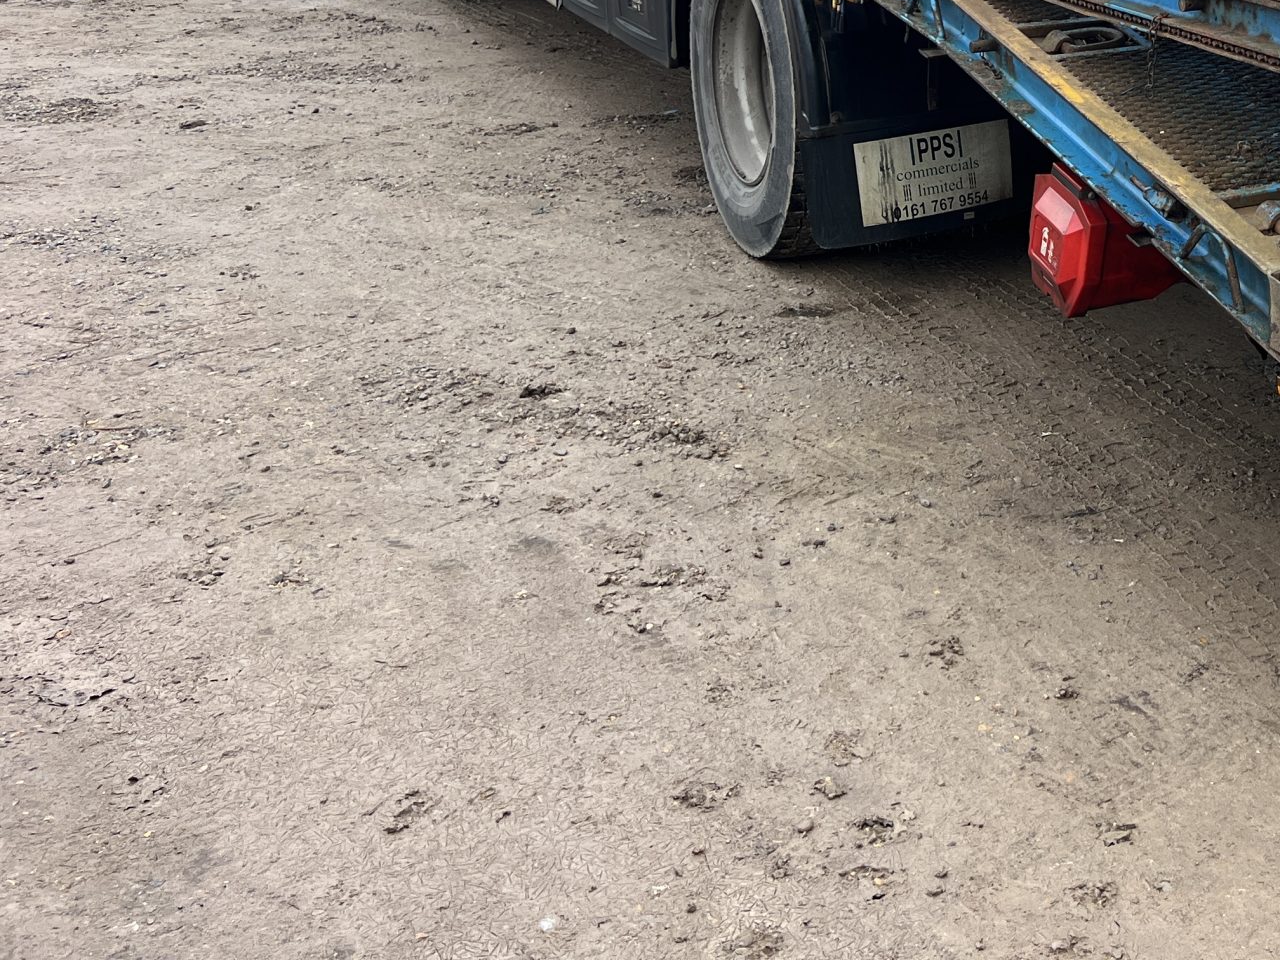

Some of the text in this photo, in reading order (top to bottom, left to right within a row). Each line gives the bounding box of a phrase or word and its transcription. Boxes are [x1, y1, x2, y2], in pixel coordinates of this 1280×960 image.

[896, 157, 980, 182] commercials
[918, 177, 964, 197] limited
[893, 190, 989, 219] 0161 767 9554
